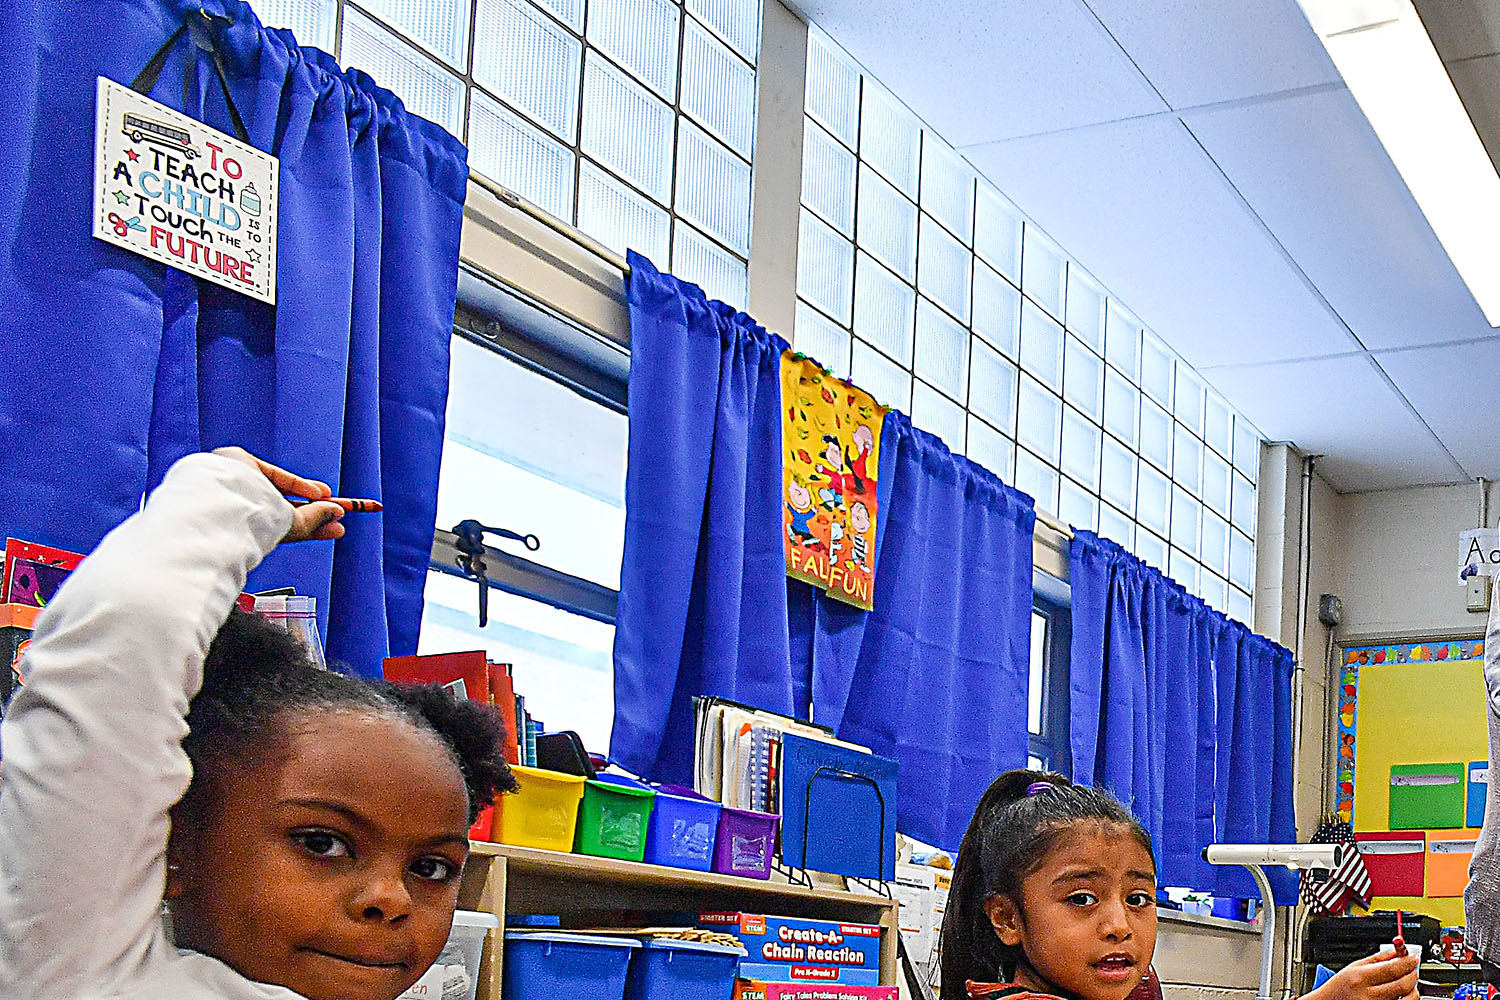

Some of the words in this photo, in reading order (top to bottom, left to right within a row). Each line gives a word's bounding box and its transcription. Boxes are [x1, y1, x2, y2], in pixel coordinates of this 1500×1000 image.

[206, 141, 243, 180] TO
[149, 147, 235, 204] TEACH
[113, 161, 133, 187] A
[139, 171, 242, 231] CHILD
[248, 218, 261, 231] IS
[218, 231, 242, 249] THE
[247, 231, 262, 243] TO
[151, 225, 262, 289] FUTURE.
[829, 566, 867, 601] FUN
[778, 925, 844, 944] Create-A-
[762, 942, 804, 960] Chain
[807, 946, 865, 965] Reaction
[741, 992, 765, 1000] STEM
[780, 992, 795, 1000] Fairy
